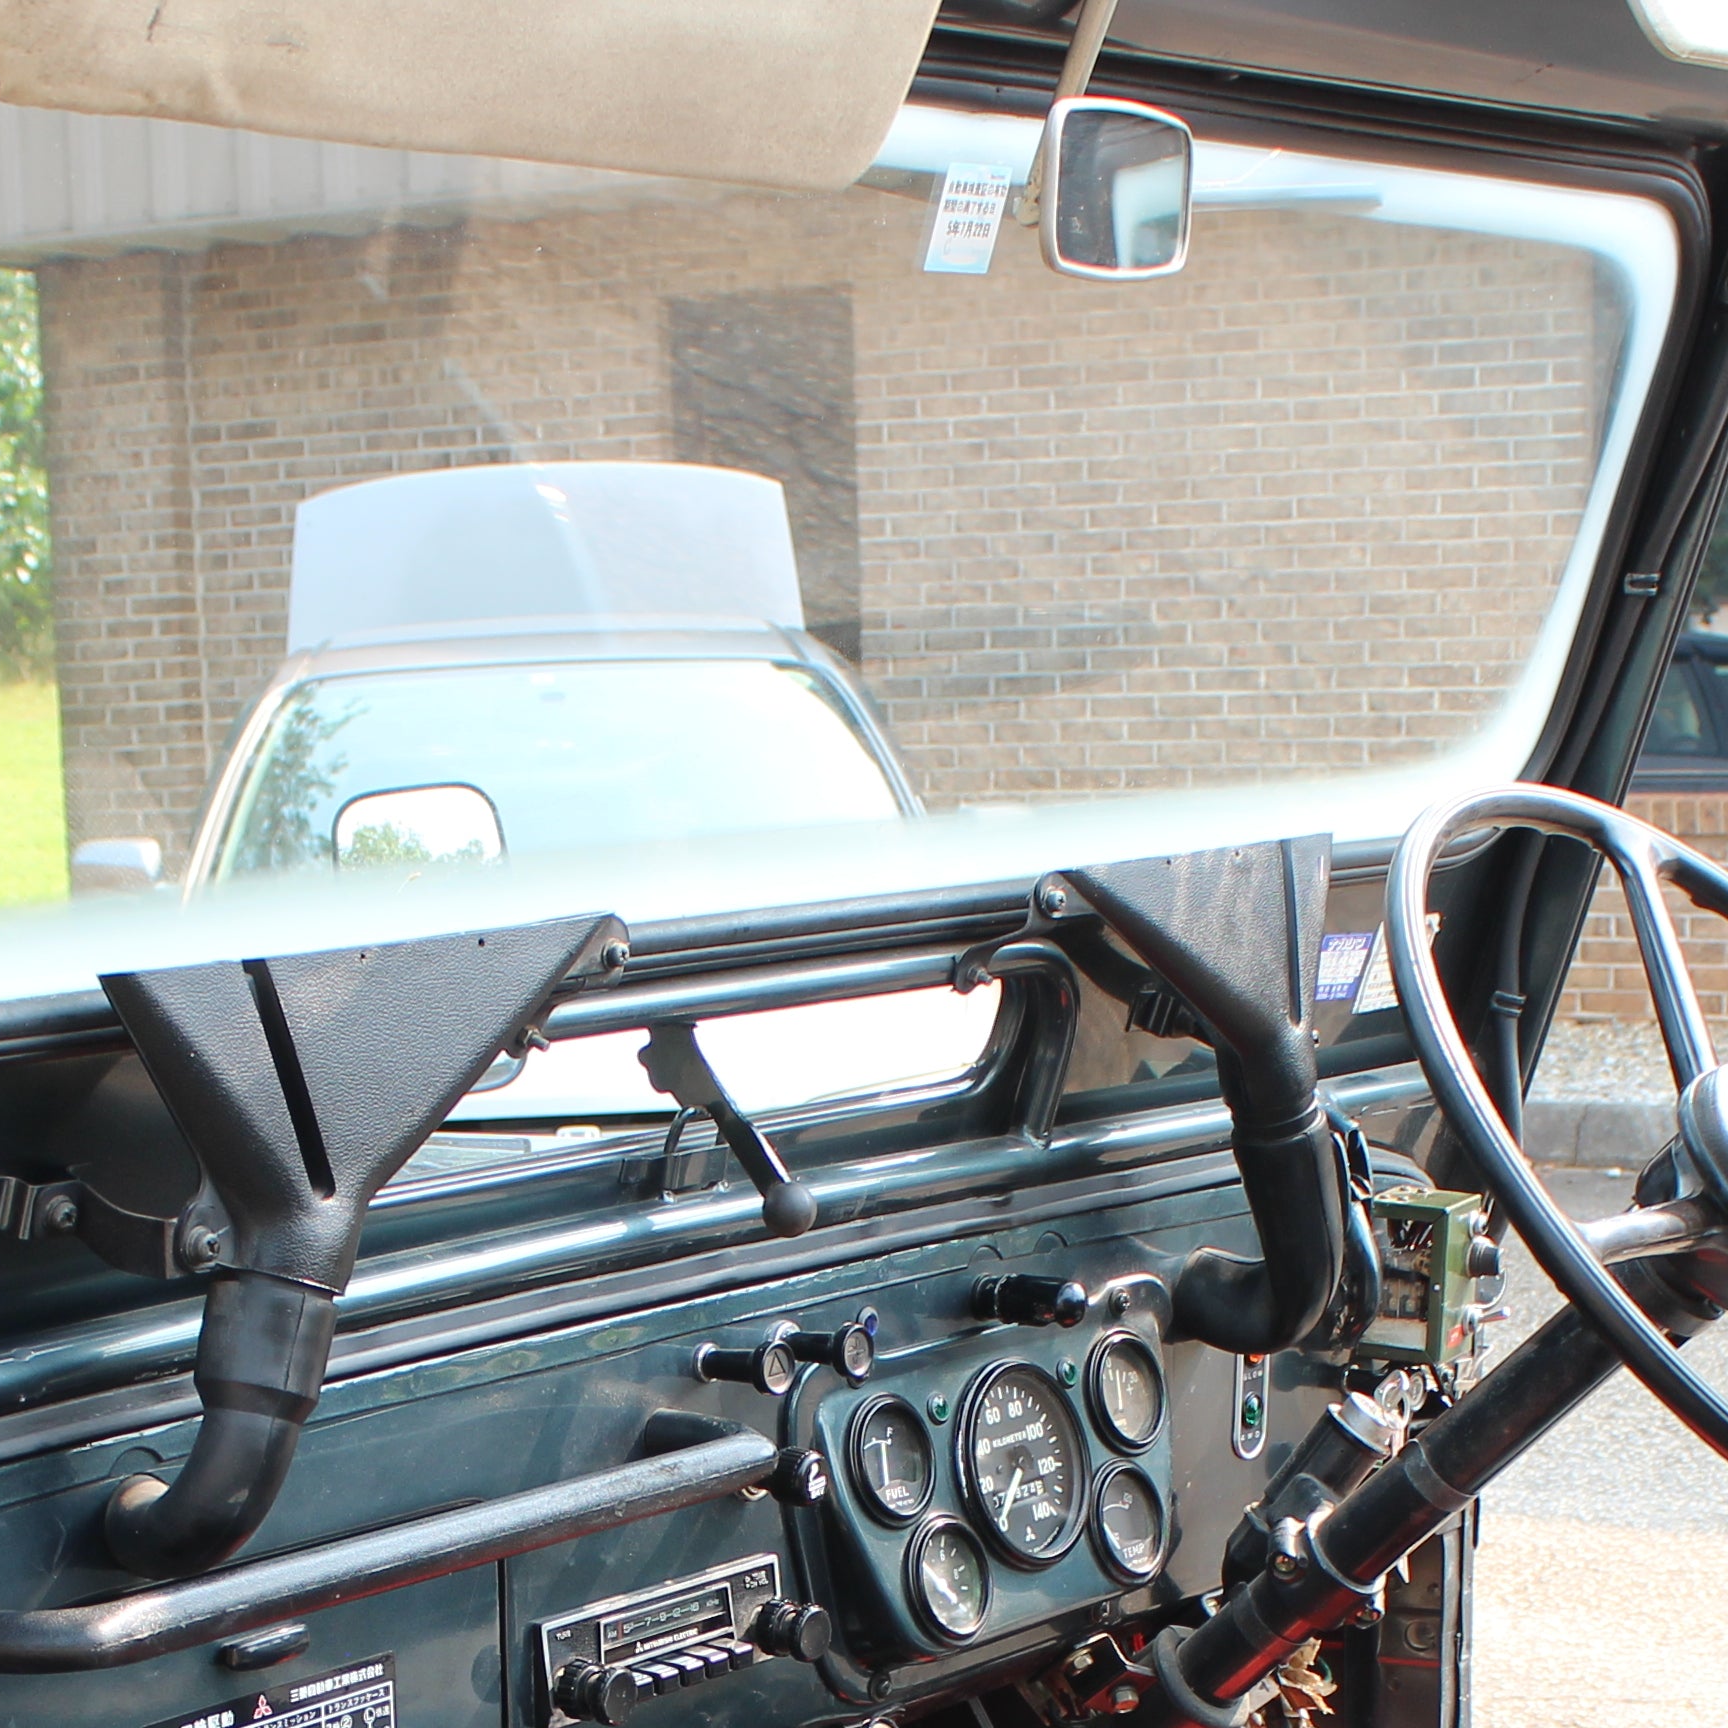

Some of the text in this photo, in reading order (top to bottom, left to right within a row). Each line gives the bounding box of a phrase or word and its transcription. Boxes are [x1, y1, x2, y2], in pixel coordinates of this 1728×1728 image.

[985, 1406, 1001, 1425] 60
[1008, 1400, 1023, 1419] 80
[1026, 1421, 1044, 1442] 100
[976, 1438, 991, 1456] 40
[1038, 1456, 1056, 1475] 120
[885, 1486, 910, 1501] FUEL
[979, 1475, 994, 1494] 20
[1032, 1501, 1050, 1522] 140
[1122, 1542, 1145, 1559] TEMP
[673, 1627, 699, 1642] ELECTRIC
